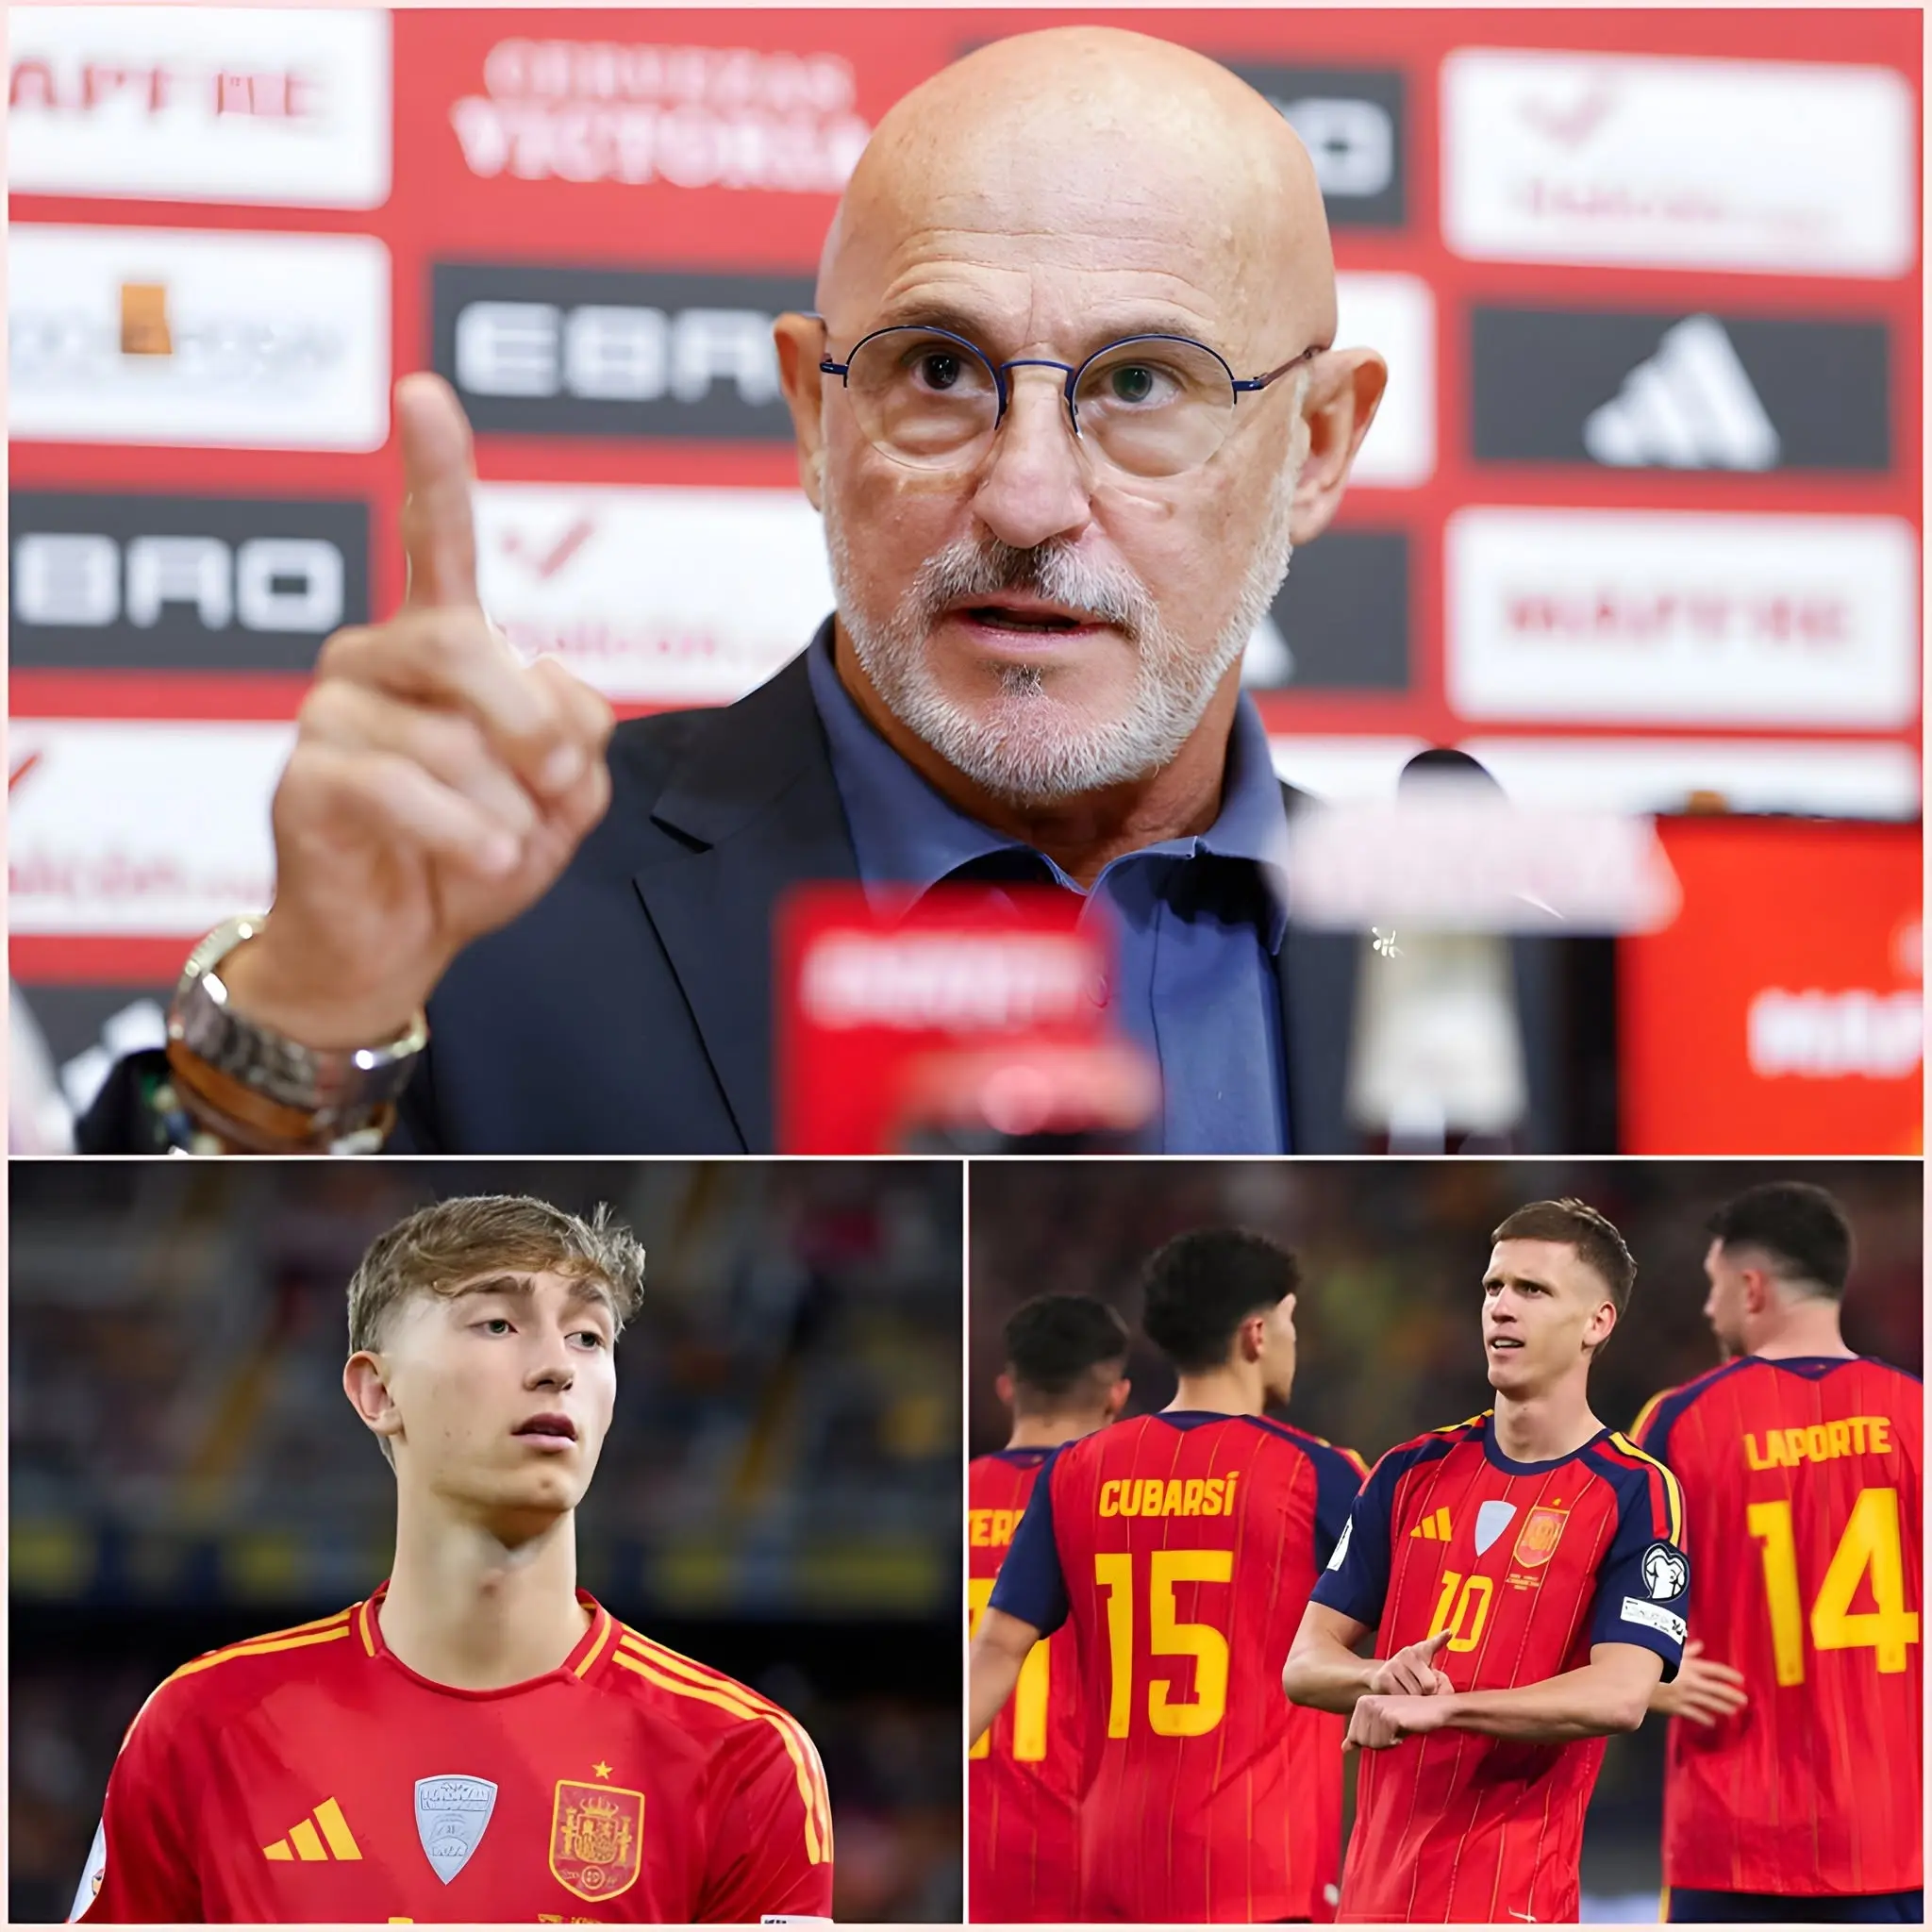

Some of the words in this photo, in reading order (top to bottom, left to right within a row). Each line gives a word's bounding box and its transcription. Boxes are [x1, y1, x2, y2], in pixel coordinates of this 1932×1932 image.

[1744, 1415, 1892, 1471] LAPORTE
[969, 1508, 1025, 1547] ER
[1099, 1470, 1240, 1518] CUBARSÍ
[1425, 1569, 1493, 1653] 10
[1747, 1487, 1920, 1687] 14
[1094, 1549, 1234, 1739] 15
